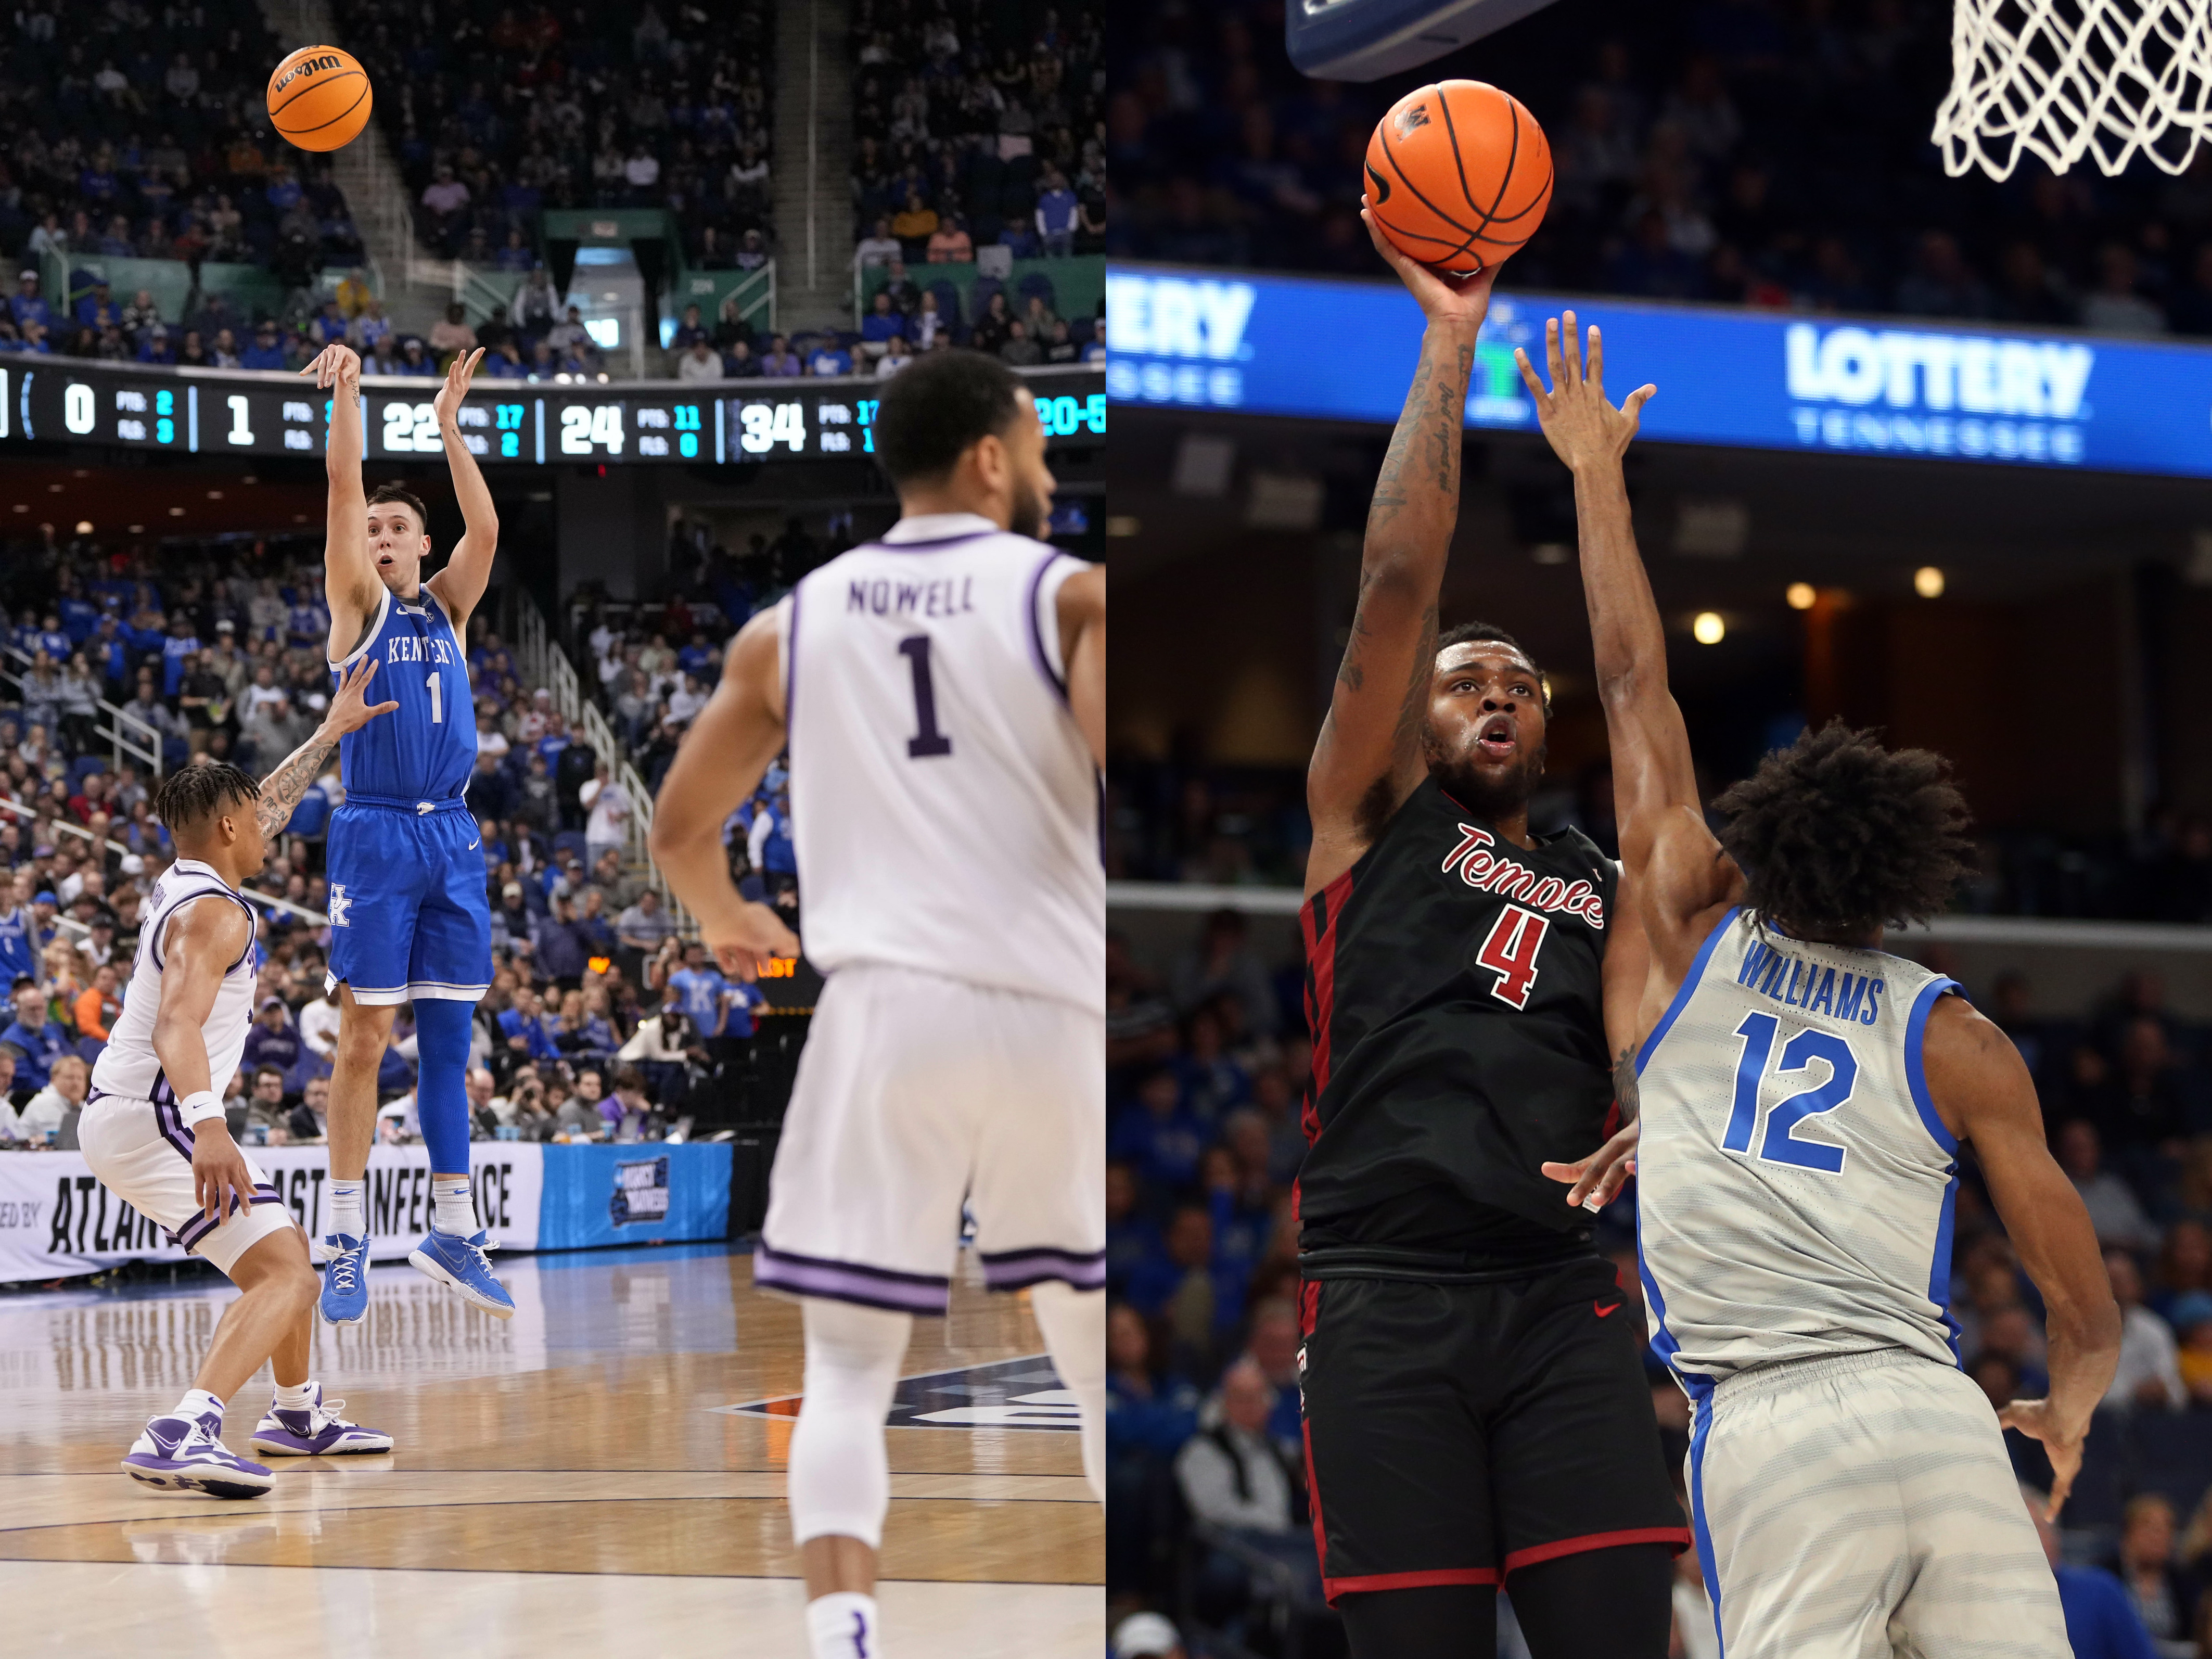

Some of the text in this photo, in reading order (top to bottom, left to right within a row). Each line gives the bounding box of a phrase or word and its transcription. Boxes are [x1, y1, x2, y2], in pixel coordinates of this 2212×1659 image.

[275, 55, 343, 93] Wilson
[1785, 322, 2093, 419] LOTTERY
[65, 384, 95, 434] 0
[228, 395, 254, 445] 1
[383, 403, 444, 452] 22
[496, 404, 524, 429] 17
[561, 406, 624, 454] 24
[674, 405, 701, 430] 11
[740, 403, 806, 452] 34
[501, 432, 519, 457] 2
[421, 597, 432, 608] NCAA
[847, 576, 973, 617] NOWELL
[388, 636, 455, 667] KENTCKY
[426, 672, 442, 723] 1
[898, 634, 951, 758] 1
[1441, 822, 1604, 929] Temple
[1475, 903, 1550, 1011] 4
[1737, 939, 1884, 1026] WILLIAMS
[1719, 1009, 1860, 1177] 12
[48, 1177, 173, 1253] ATLAN
